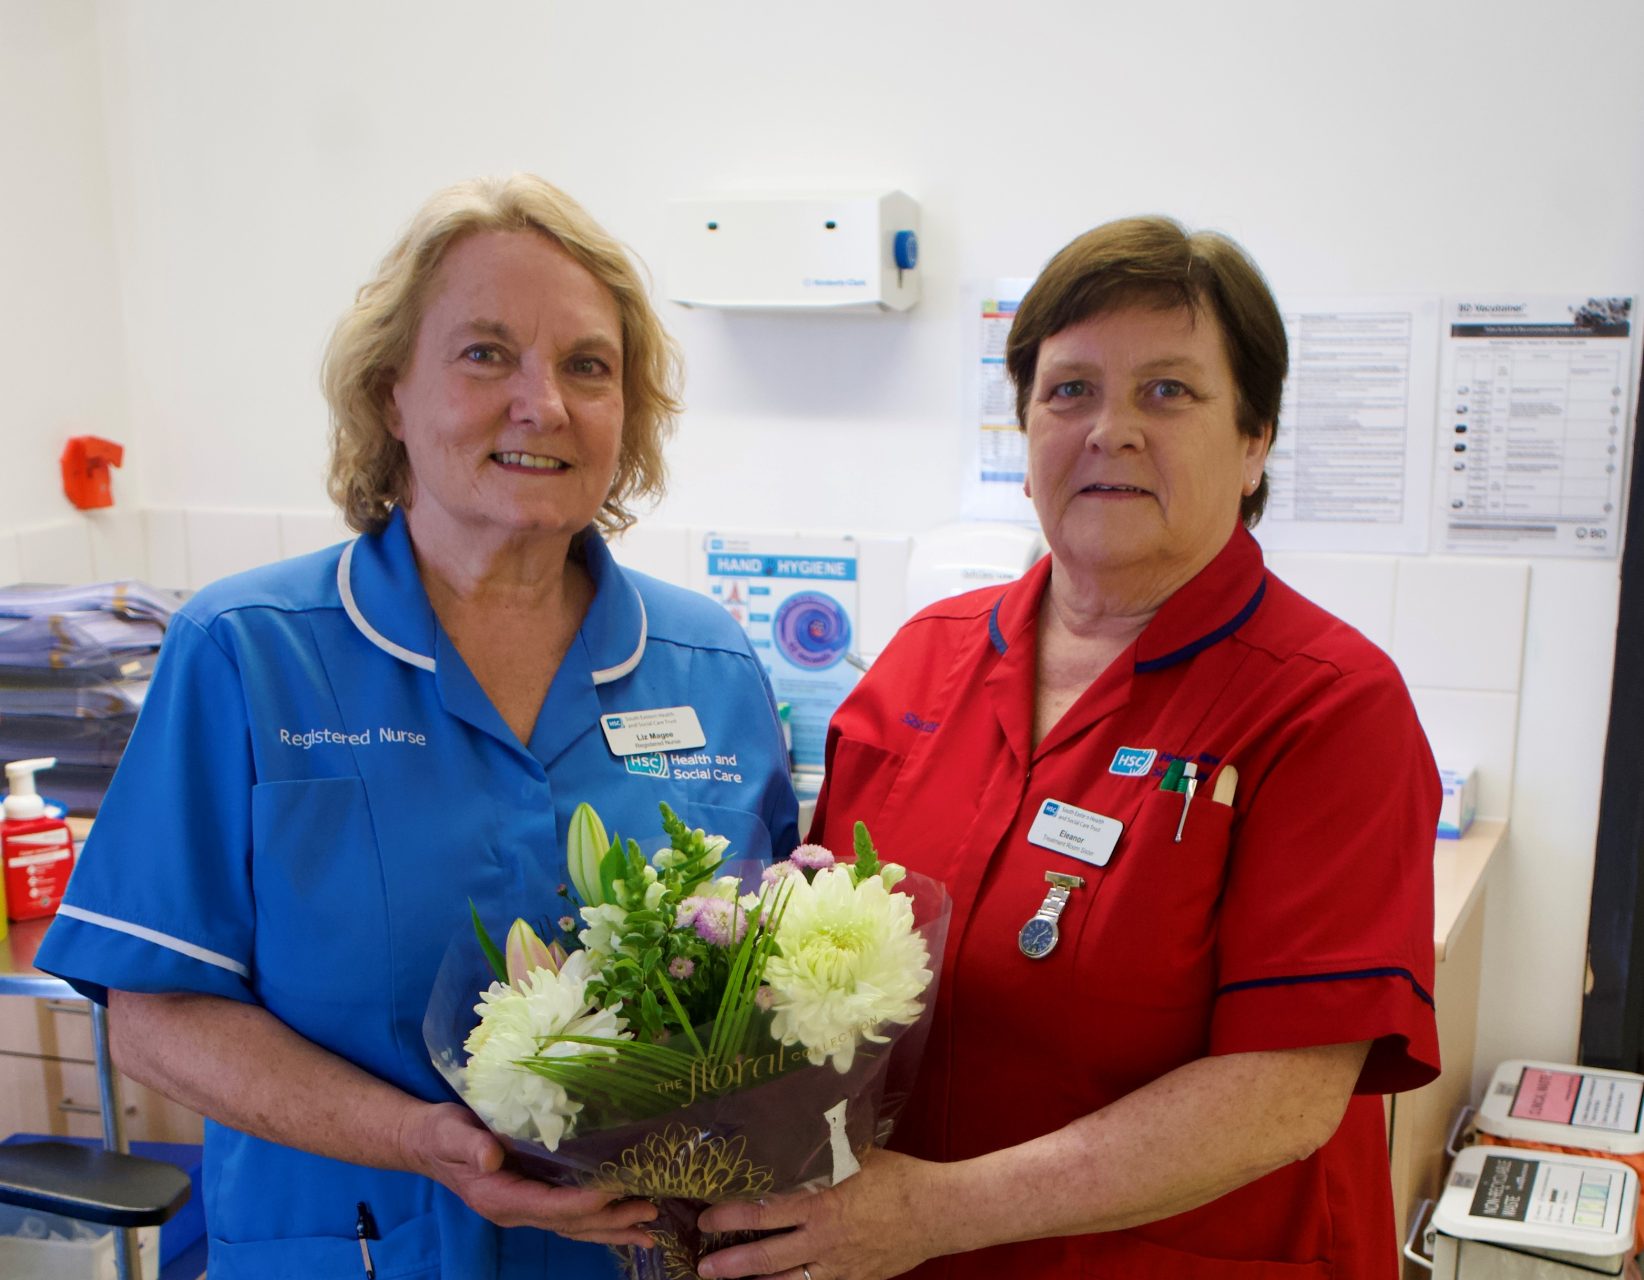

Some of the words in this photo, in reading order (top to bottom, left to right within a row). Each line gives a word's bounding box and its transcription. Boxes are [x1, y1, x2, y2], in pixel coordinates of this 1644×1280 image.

[717, 557, 762, 572] HAND
[777, 559, 847, 576] HYGIENE
[280, 728, 371, 750] Registered
[379, 727, 426, 746] Nurse
[631, 755, 660, 769] HSC
[670, 753, 711, 765] Health
[715, 754, 737, 766] and
[1118, 754, 1146, 768] HSC
[673, 769, 711, 780] Social
[713, 770, 743, 784] Care
[1059, 829, 1085, 844] Eleanor
[655, 1079, 684, 1093] THE
[680, 1042, 785, 1108] floral
